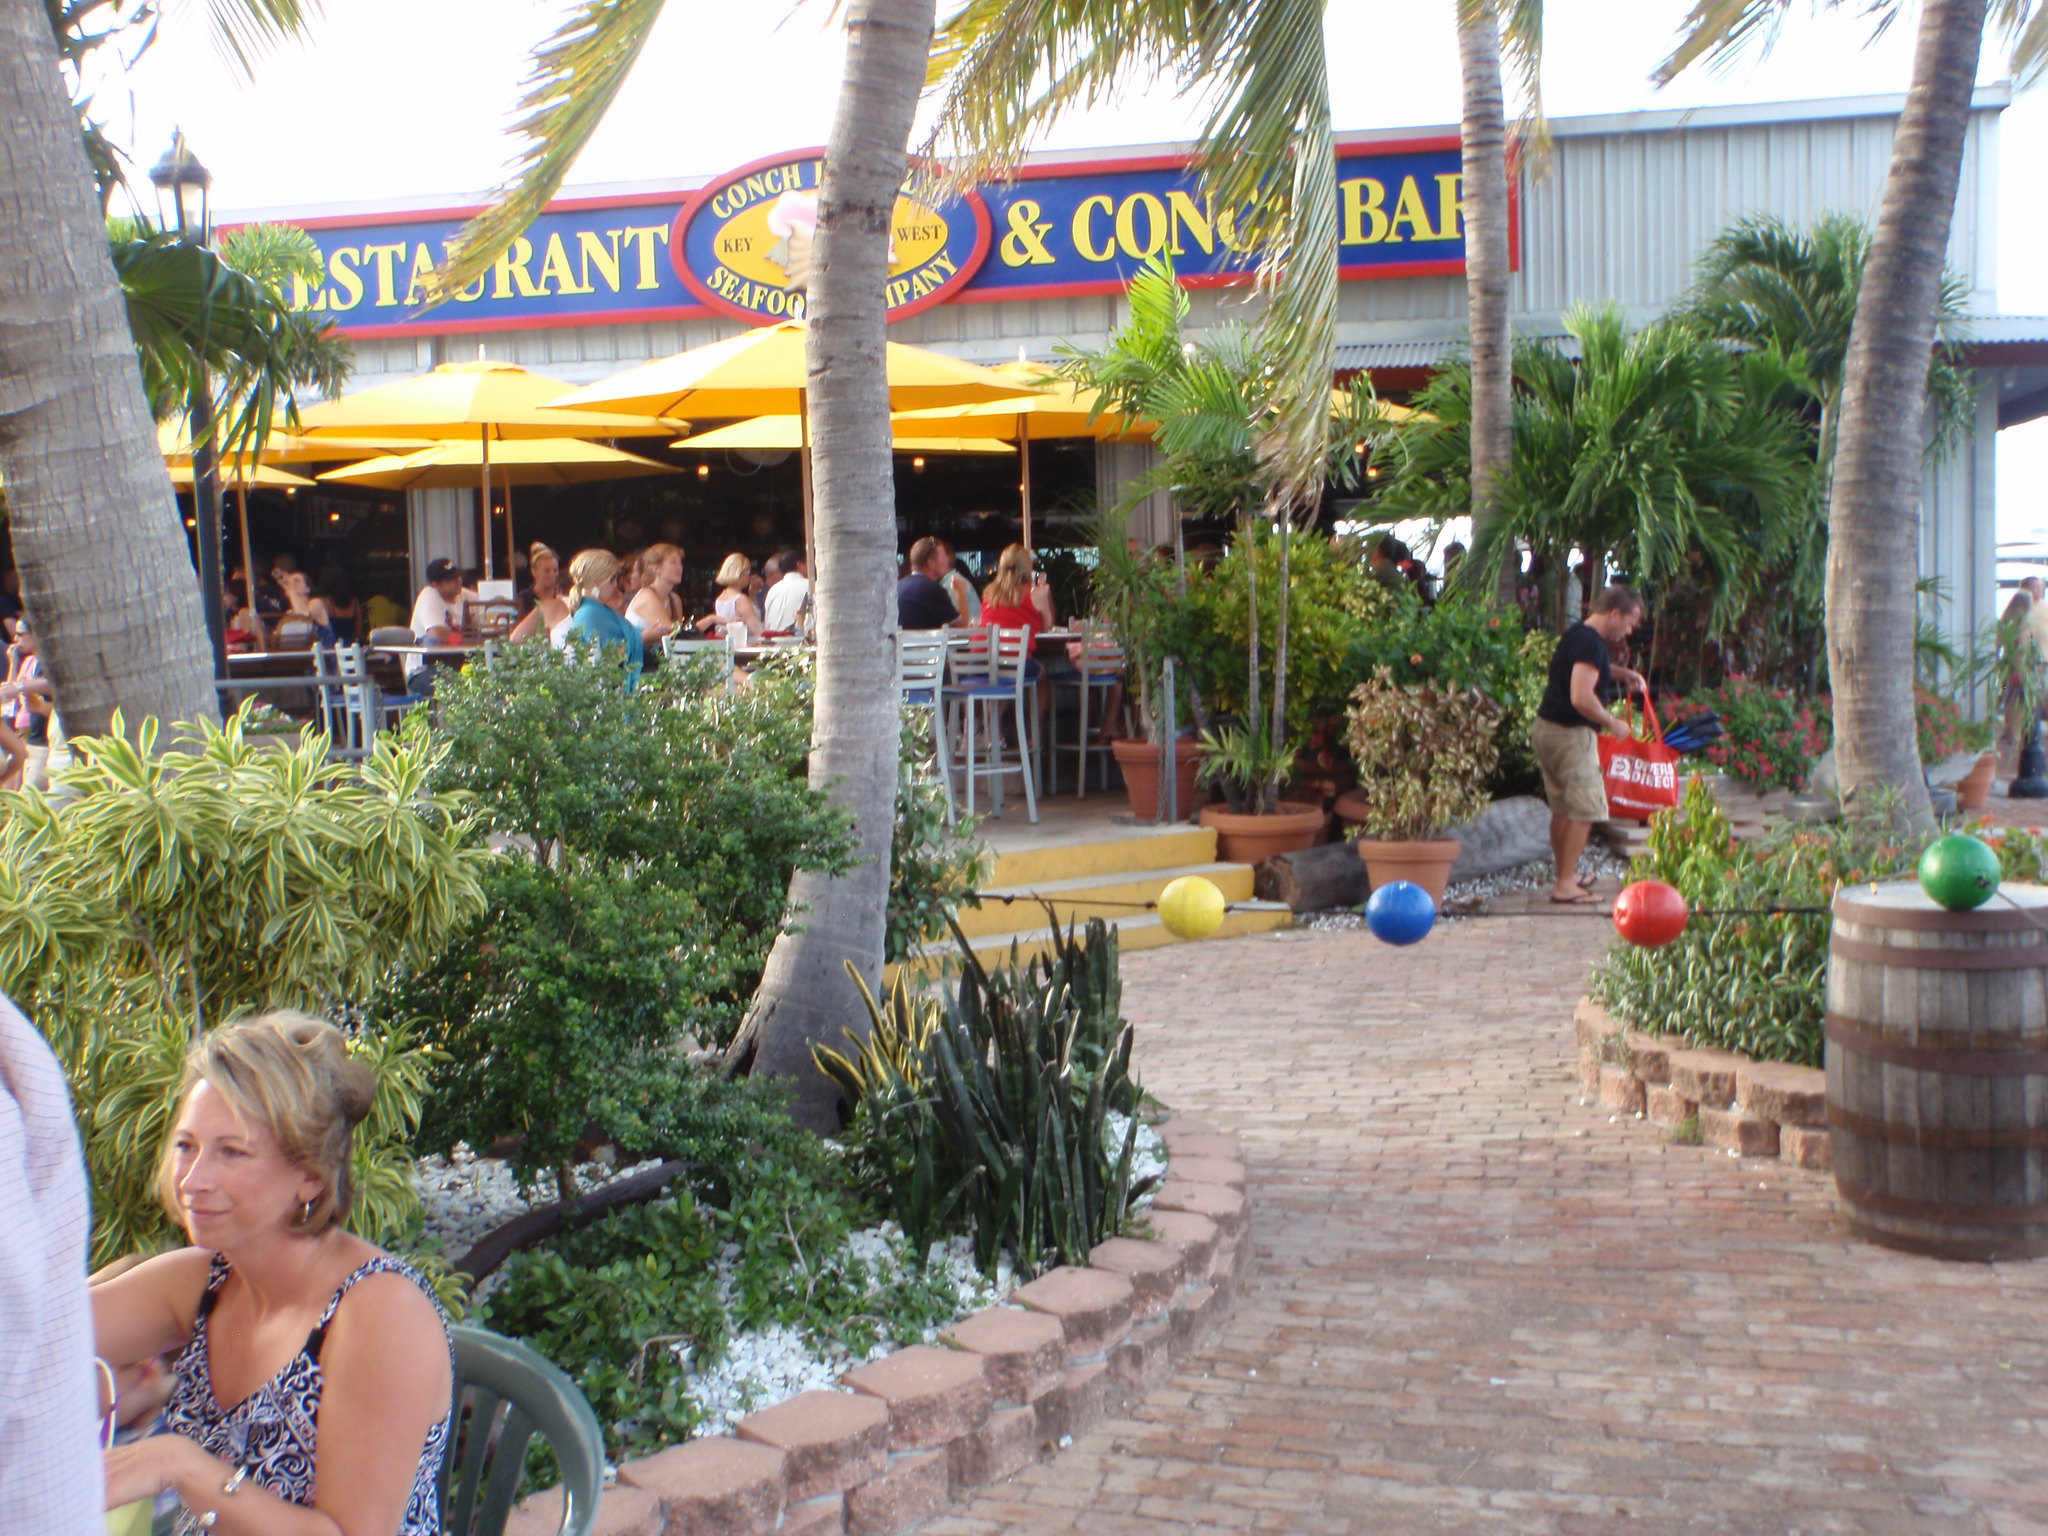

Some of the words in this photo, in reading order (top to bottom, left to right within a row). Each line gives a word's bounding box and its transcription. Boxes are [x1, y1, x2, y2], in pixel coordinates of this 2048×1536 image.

[712, 163, 802, 219] CONCH
[285, 223, 669, 313] ESTAURANT
[1000, 199, 1056, 268] &
[1071, 187, 1285, 263] CONC
[723, 237, 753, 253] KEY
[896, 224, 942, 242] WEST
[706, 265, 806, 318] SEAFOO
